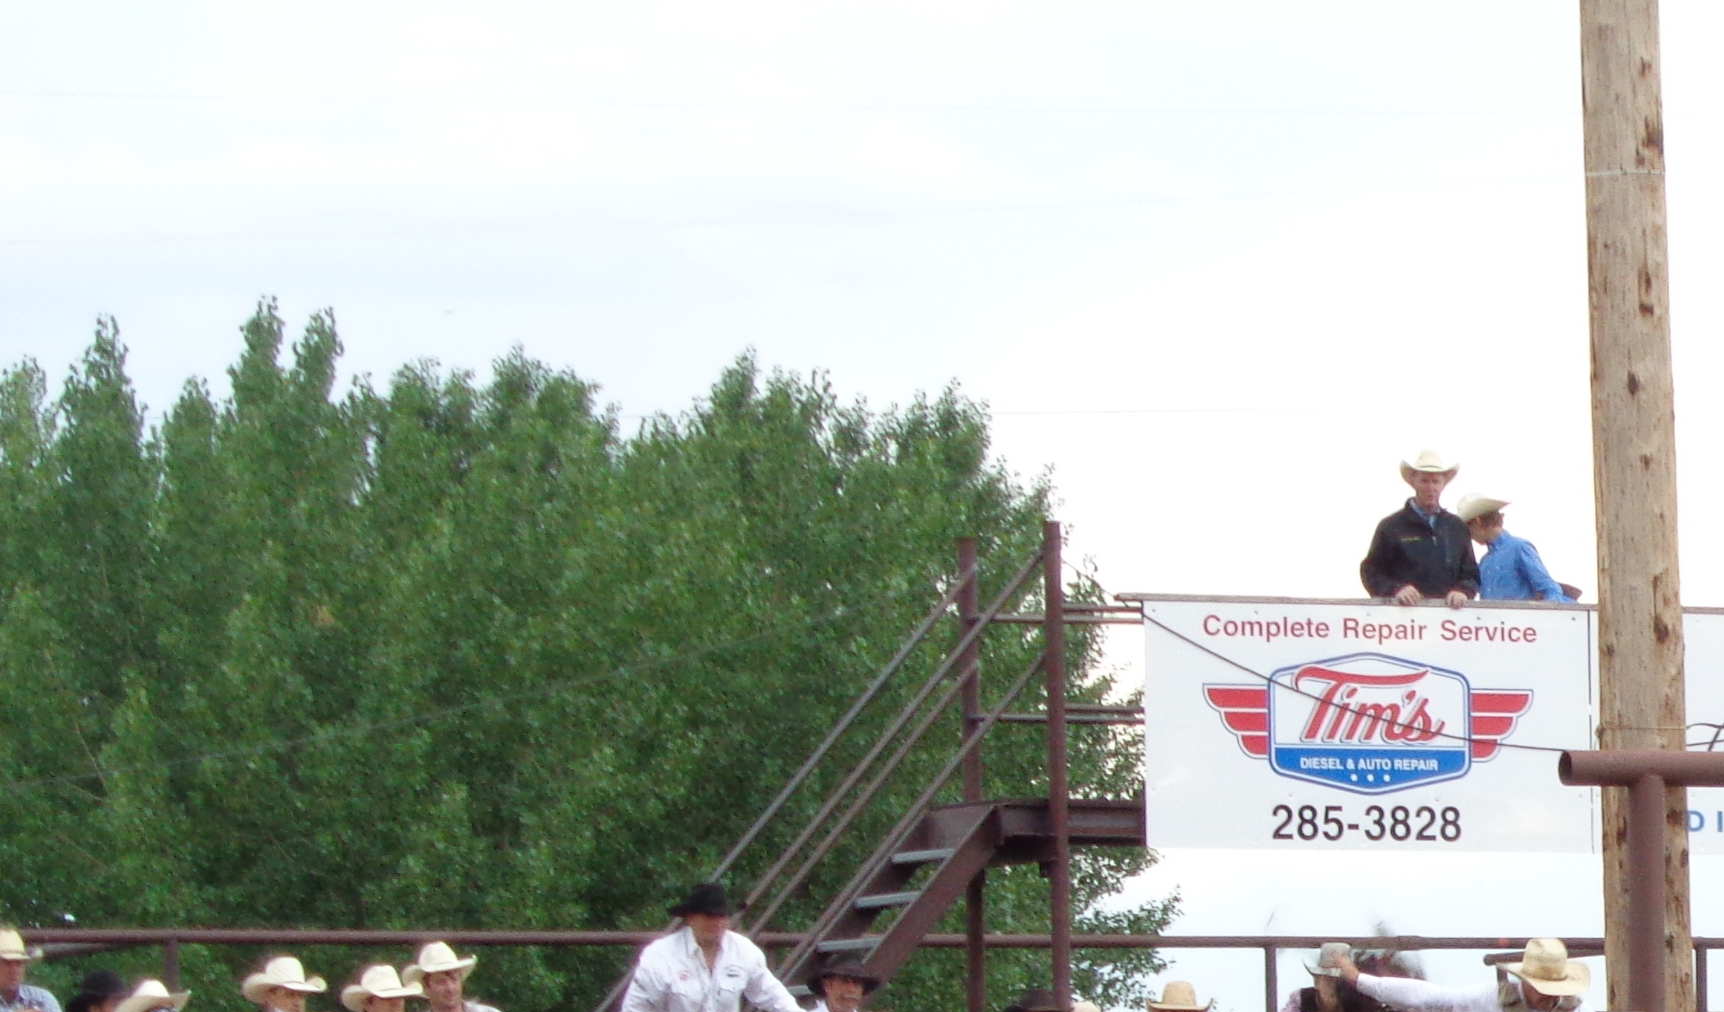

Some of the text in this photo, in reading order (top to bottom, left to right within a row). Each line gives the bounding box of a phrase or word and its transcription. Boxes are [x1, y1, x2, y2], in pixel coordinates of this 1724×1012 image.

[1202, 614, 1537, 645] Complete Repair Service
[1293, 663, 1446, 744] Tim's
[1300, 757, 1439, 771] DIESEL & AUTO REPAIR
[1271, 804, 1462, 842] 285-3828
